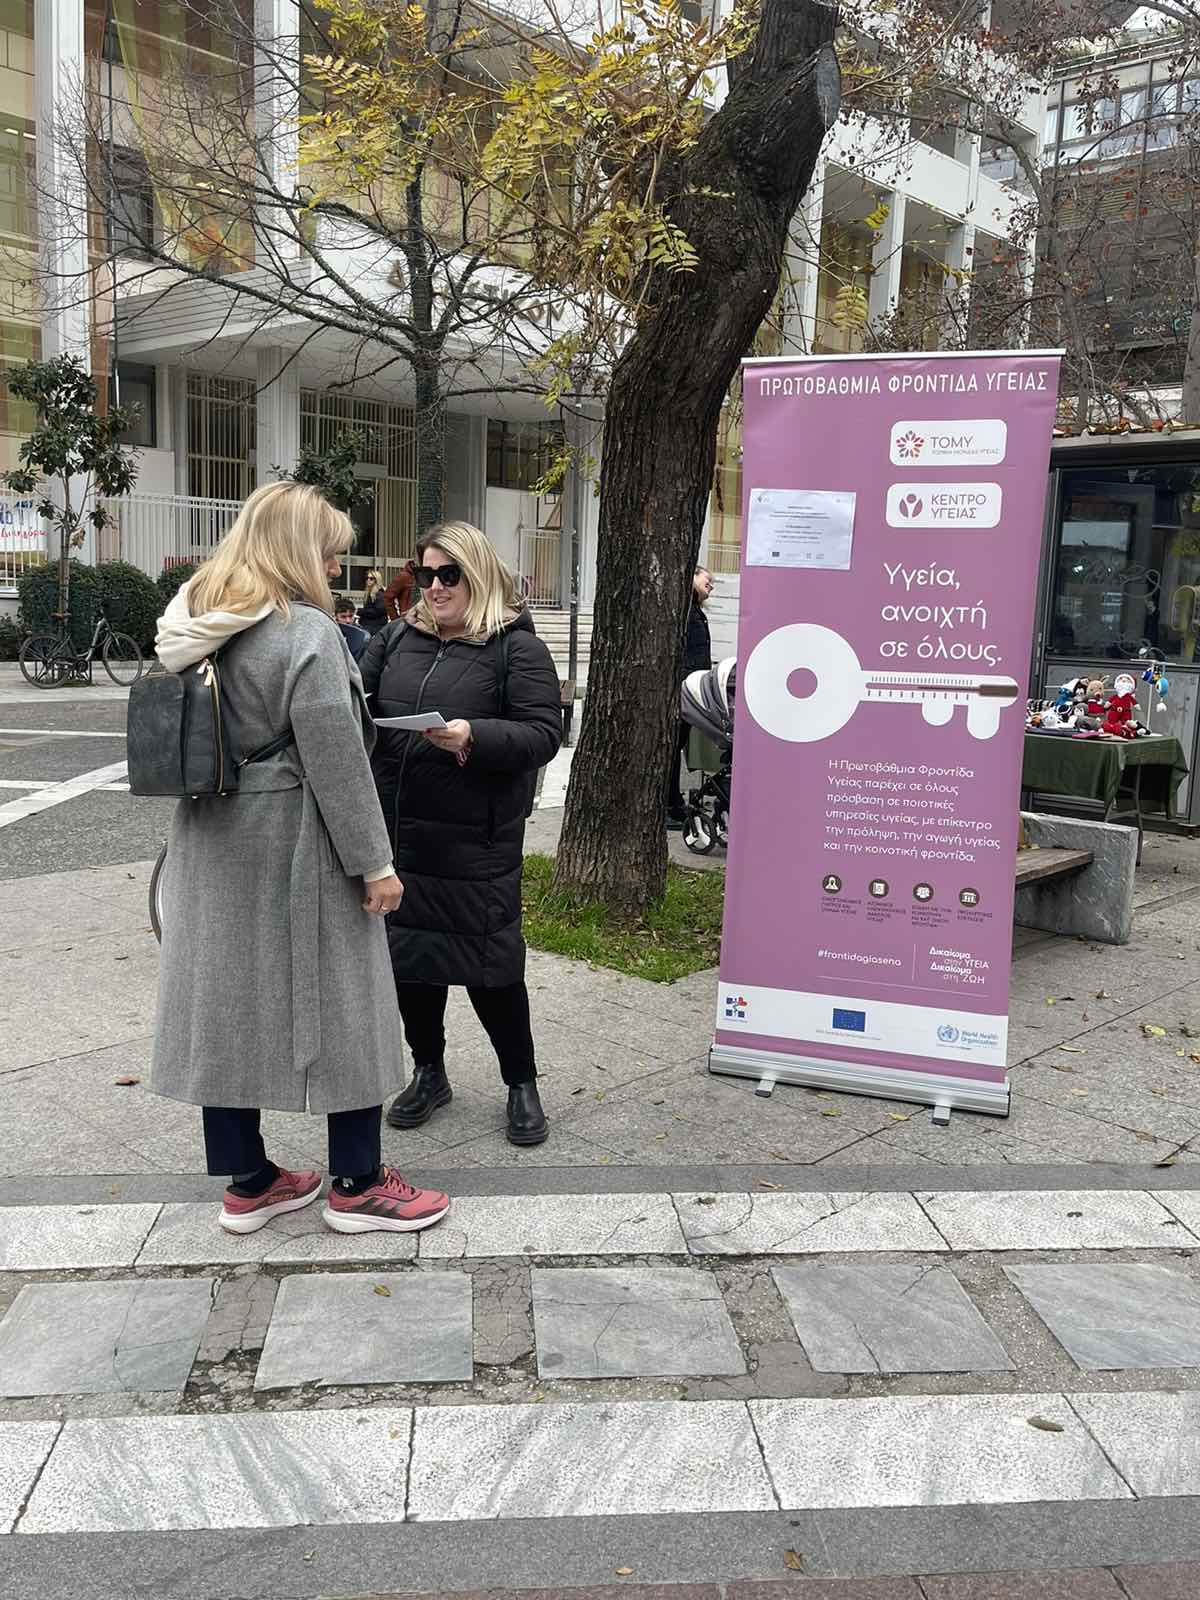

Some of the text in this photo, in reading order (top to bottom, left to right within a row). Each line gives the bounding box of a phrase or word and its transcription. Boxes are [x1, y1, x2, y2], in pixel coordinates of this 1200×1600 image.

[760, 372, 1048, 396] ΠΡΩΤΟΒΑΘΜΙΑ ΦΡΟΝΤΙΔΑ ΥΓΕΙΑΣ
[931, 494, 987, 506] ΚΕΝΤΡΟ
[931, 507, 977, 520] ΥΓΕΙΑΣ
[883, 561, 960, 592] Υγεία,
[881, 599, 987, 630] ανοιχτή
[880, 634, 1002, 667] σε όλους.
[828, 760, 975, 778] Η Πρωτοβάθμια Φροντίδα
[828, 776, 959, 796] Υγείας παρέχει σε όλους
[827, 793, 954, 812] πρόσβαση σε ποιοτικές
[826, 810, 879, 824] υπηρεσίες
[922, 817, 936, 826] με
[938, 816, 993, 832] επίκεντρο
[825, 825, 1001, 850] την πρόληψη, την αγωγή υγείας
[824, 841, 840, 850] και
[844, 842, 864, 854] την
[865, 844, 918, 858] κοινοτική
[928, 946, 972, 960] Δικαίωμα
[930, 962, 972, 976] Δικαίωμα
[964, 958, 990, 969] ΥΓΕΙΑ
[962, 973, 985, 984] ΖΩΗ
